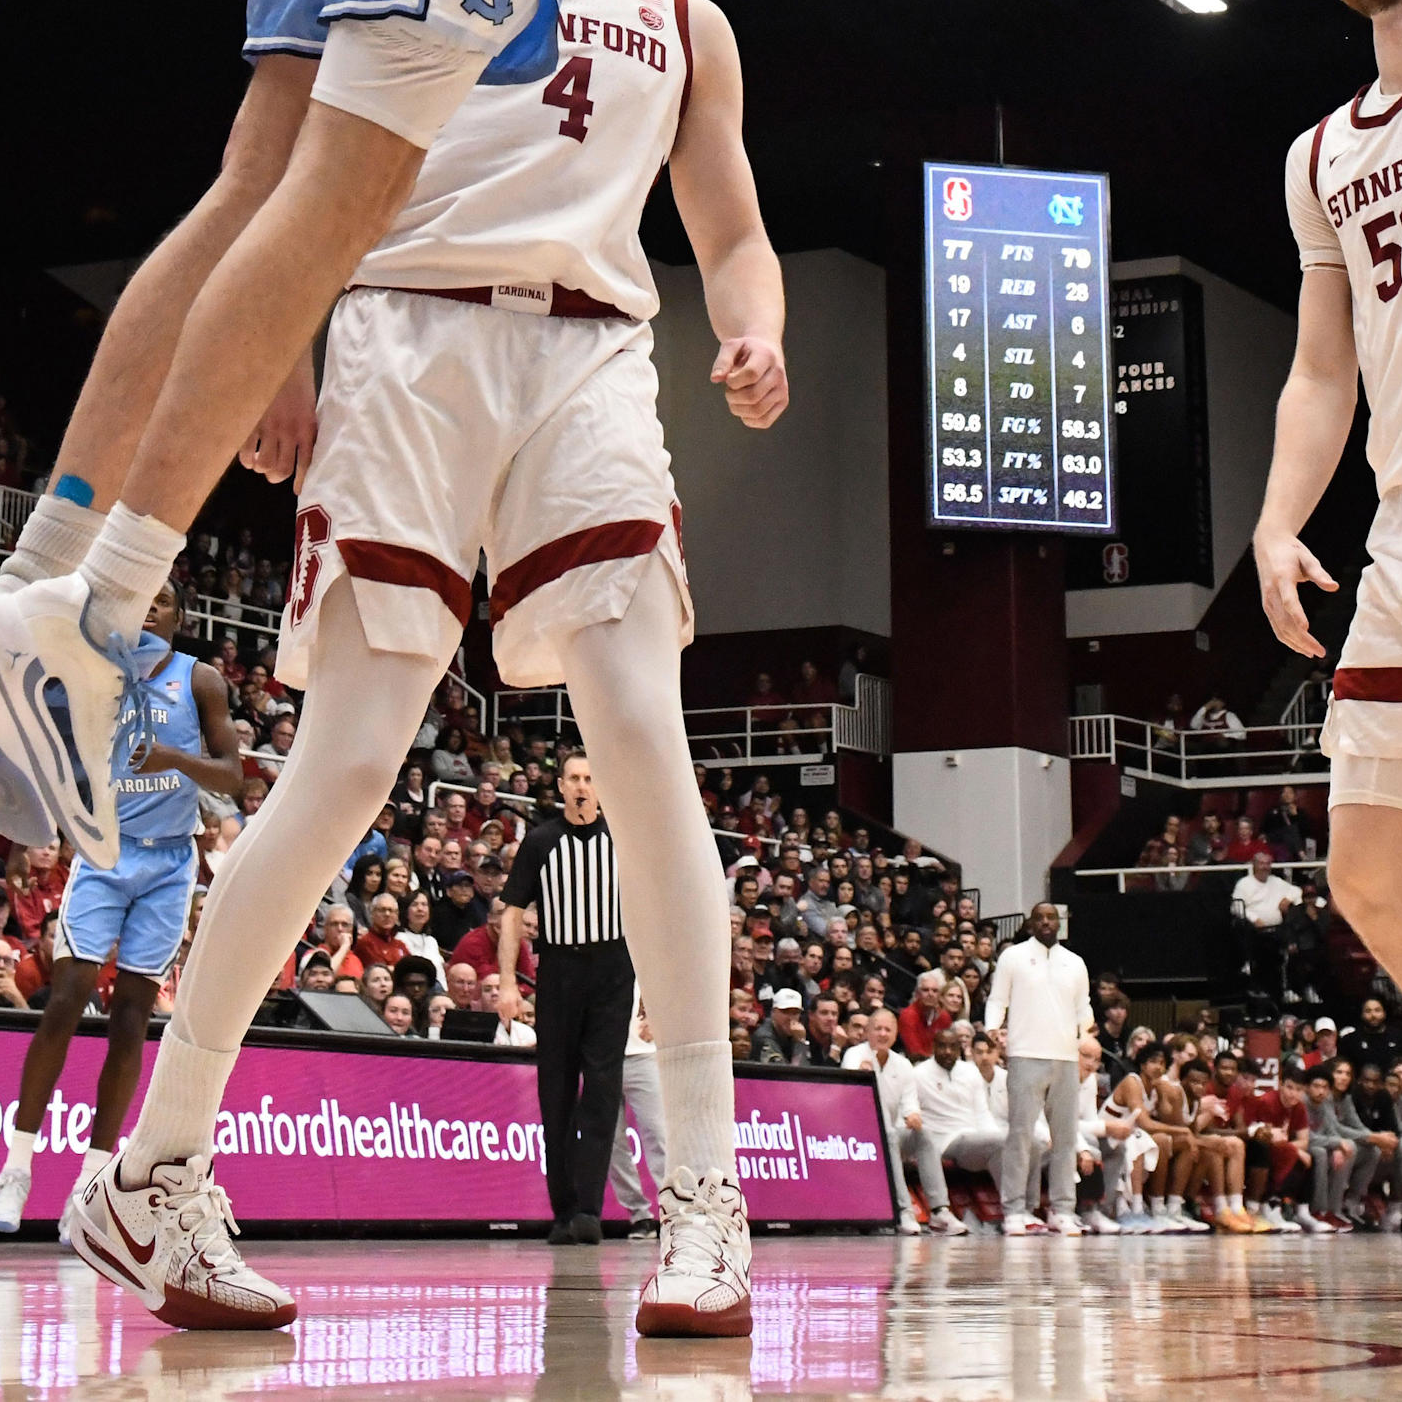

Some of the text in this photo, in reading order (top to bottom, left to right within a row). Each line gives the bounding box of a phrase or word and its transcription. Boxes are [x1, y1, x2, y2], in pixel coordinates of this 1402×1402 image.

[542, 55, 595, 144] 4
[942, 239, 1093, 270] 77 PTS 79
[498, 285, 547, 302] CARDINAL
[948, 274, 971, 295] 19
[999, 278, 1037, 297] REB
[948, 308, 972, 328] 17
[1002, 313, 1038, 331] AST
[952, 342, 1086, 370] 4 STL 4
[1118, 361, 1165, 379] FOUR
[953, 377, 1087, 404] 8 TO 7
[1117, 376, 1176, 394] ANCES
[942, 448, 983, 468] 53.3
[998, 486, 1048, 506] 3PT%
[1062, 489, 1103, 510] 46.2
[212, 1094, 548, 1176] anfordhealthcare.or
[806, 1134, 878, 1161] Health Care
[734, 1155, 800, 1180] DICINE
